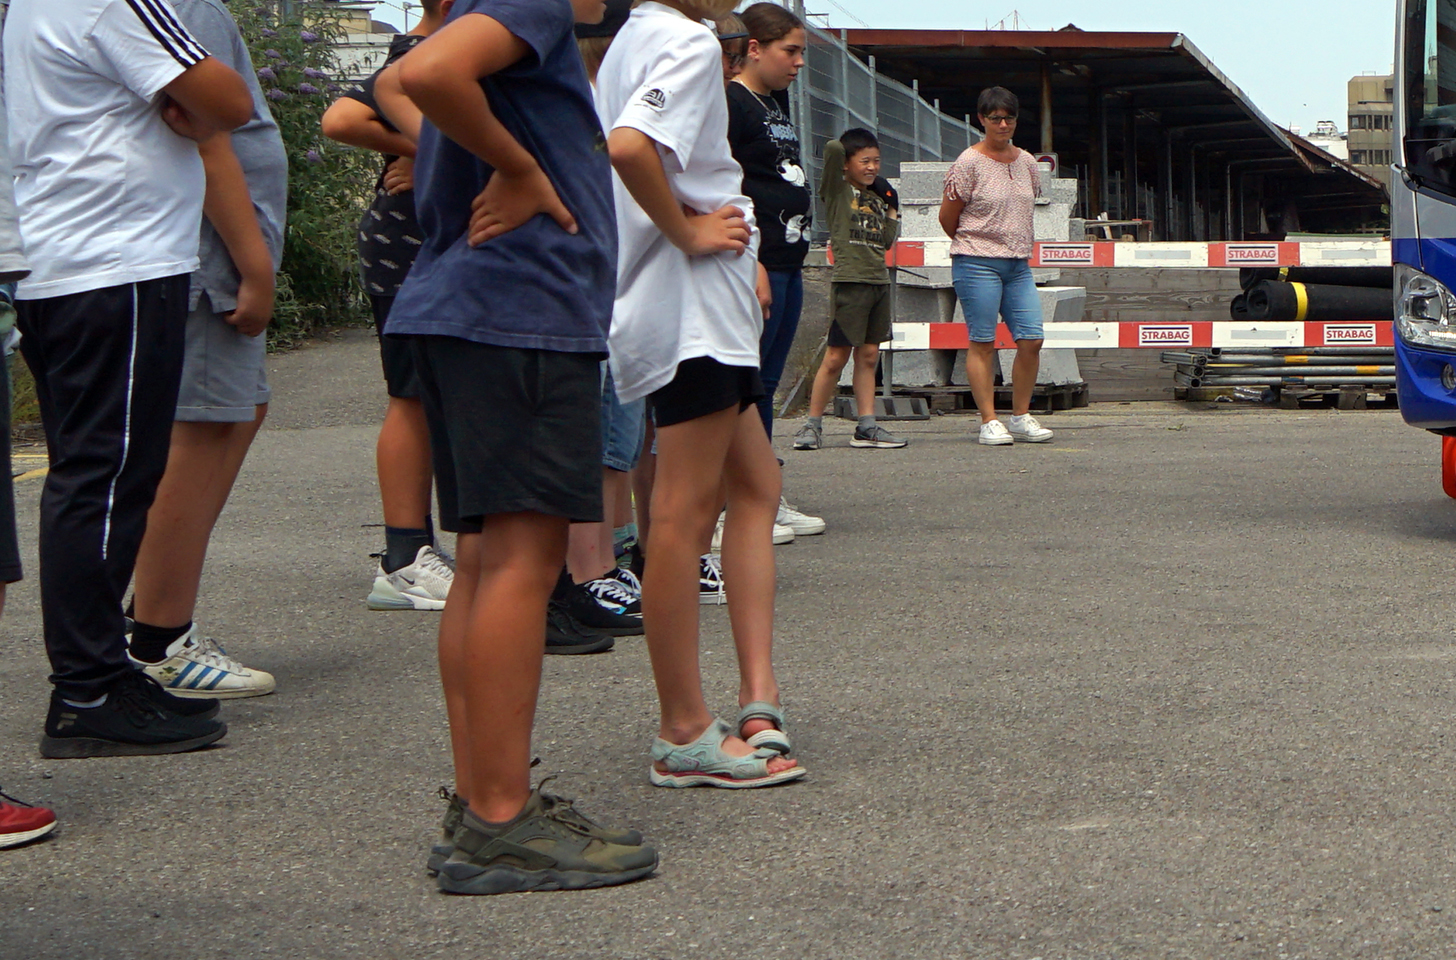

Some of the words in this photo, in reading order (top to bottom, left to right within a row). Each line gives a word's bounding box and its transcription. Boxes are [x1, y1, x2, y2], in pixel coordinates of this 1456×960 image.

[1042, 249, 1092, 259] STRABAG
[1228, 249, 1277, 259] STRABAG
[1141, 330, 1190, 340] STRABAG
[1326, 329, 1374, 339] STRABAG
